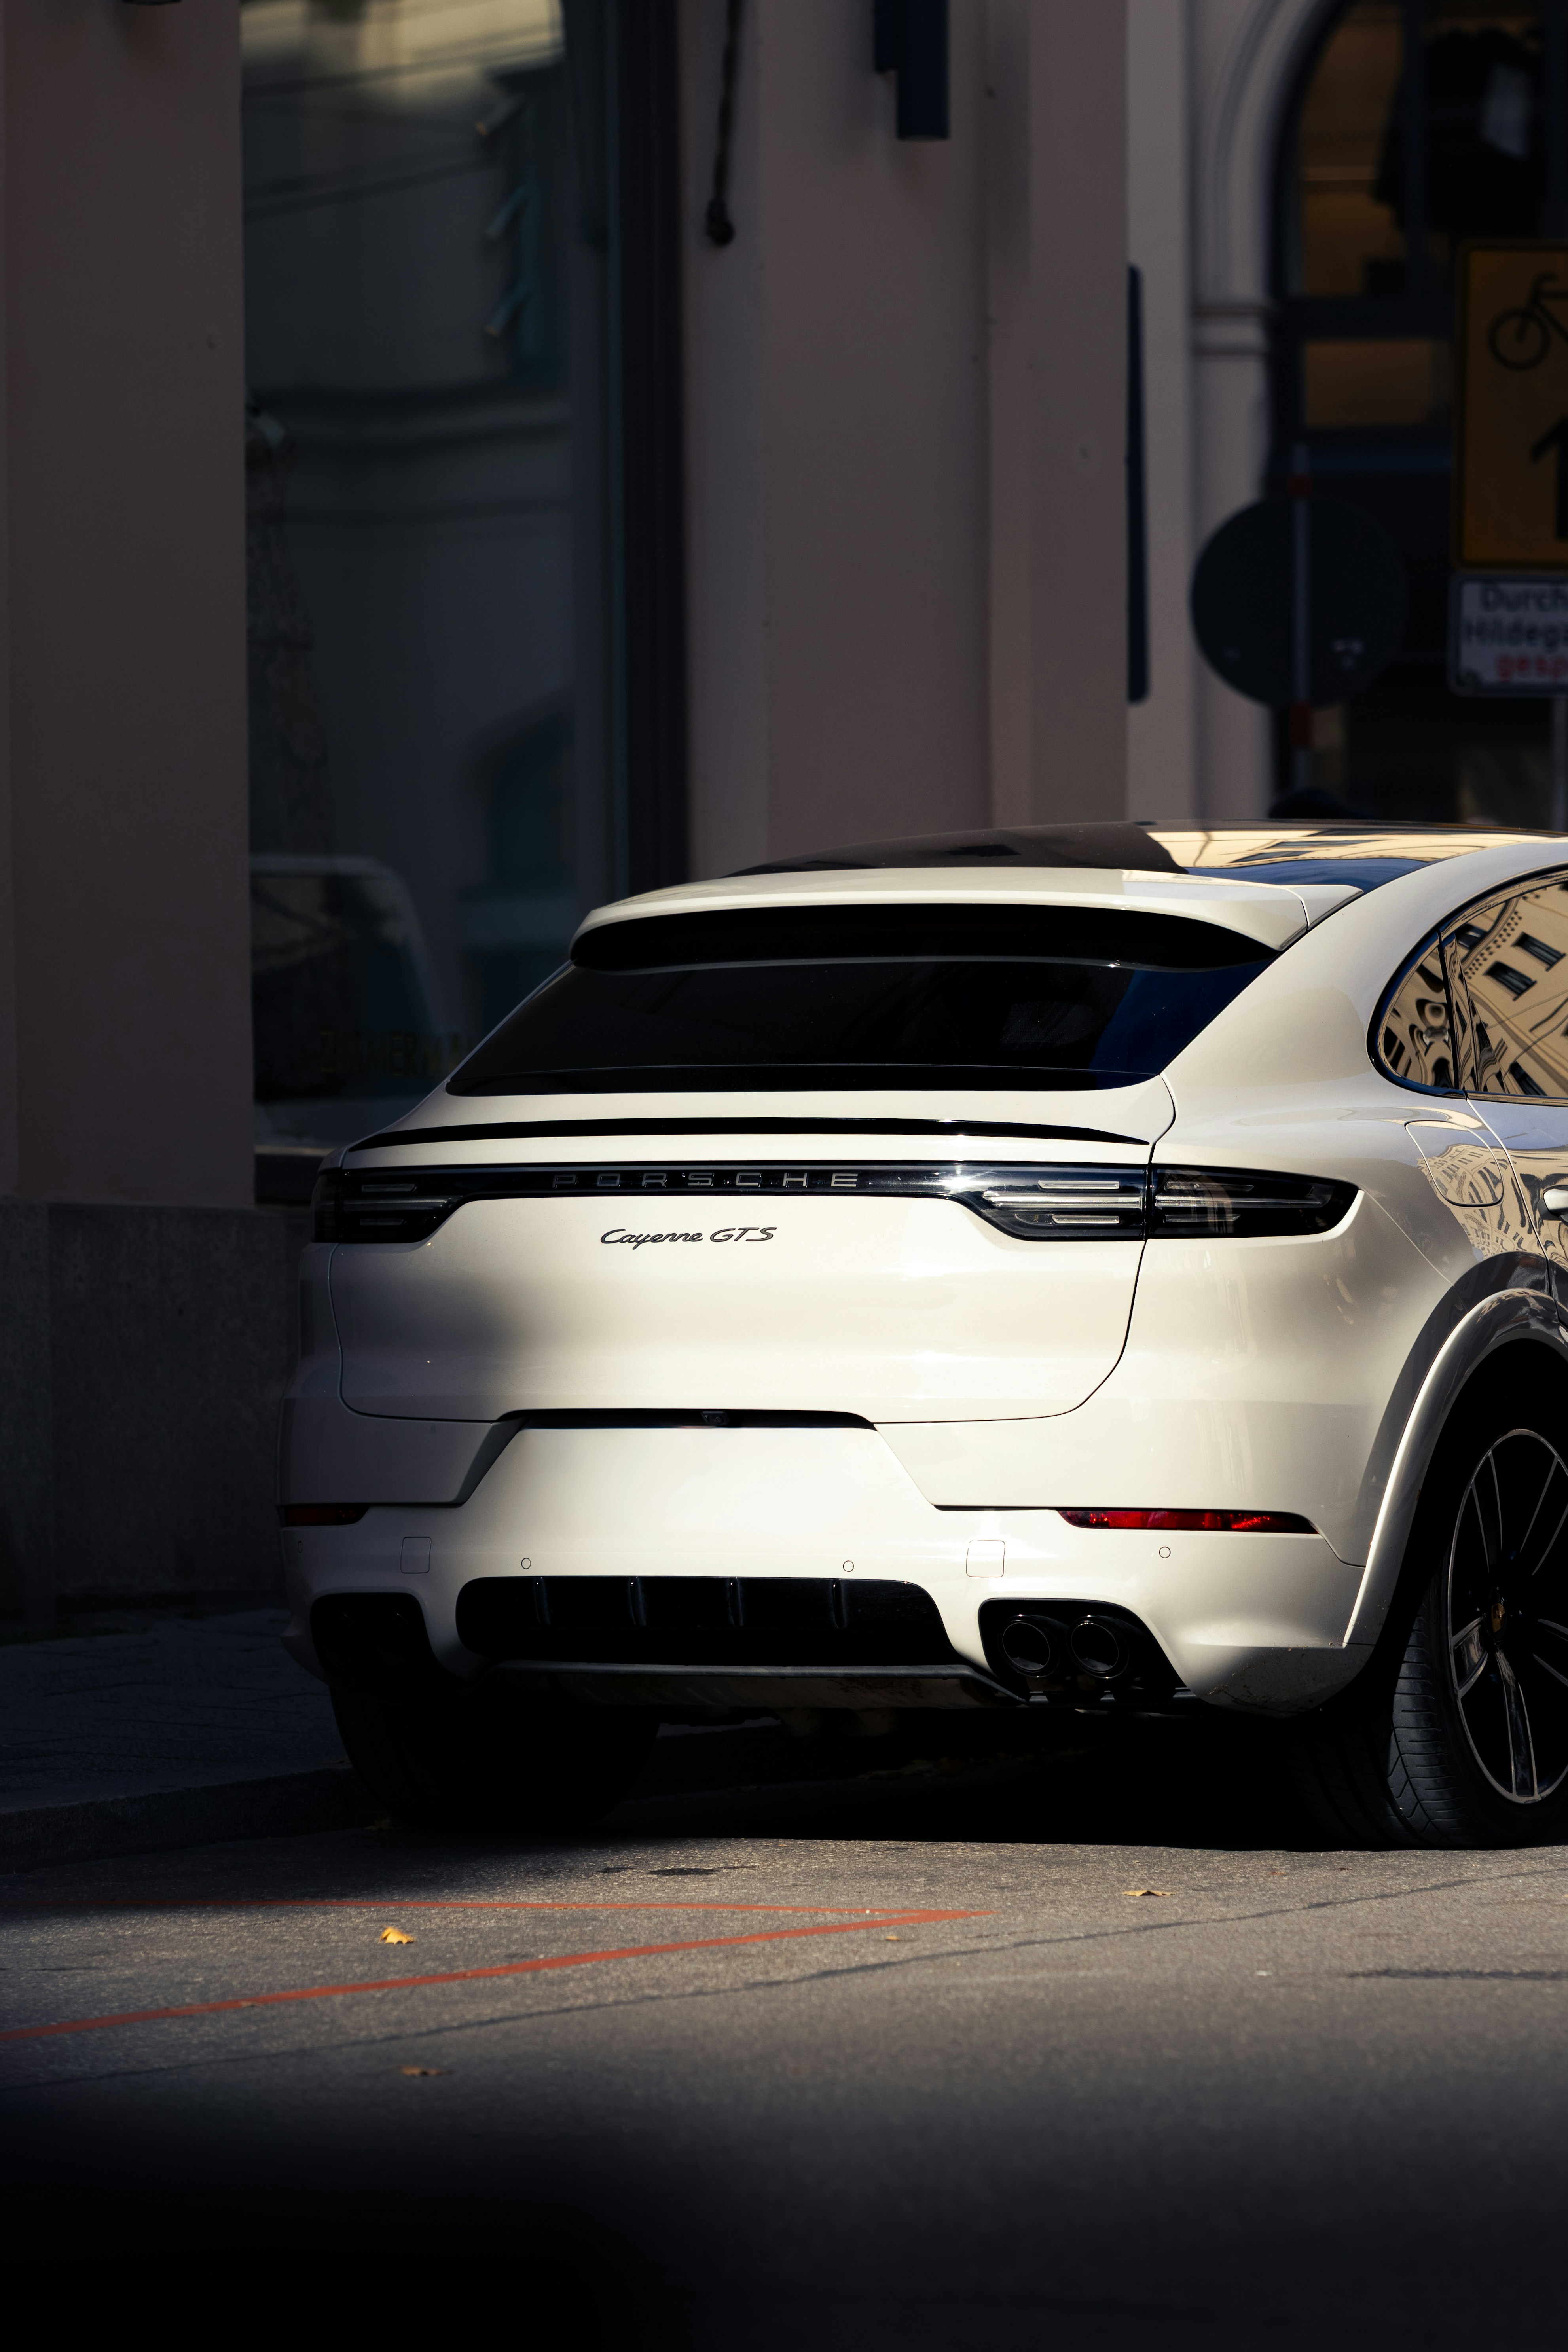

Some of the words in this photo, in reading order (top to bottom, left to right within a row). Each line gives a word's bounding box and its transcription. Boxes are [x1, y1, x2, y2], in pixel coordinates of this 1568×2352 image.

[552, 1172, 858, 1188] PORSCHE
[600, 1228, 703, 1250] Cayenne
[710, 1227, 778, 1243] GTS
